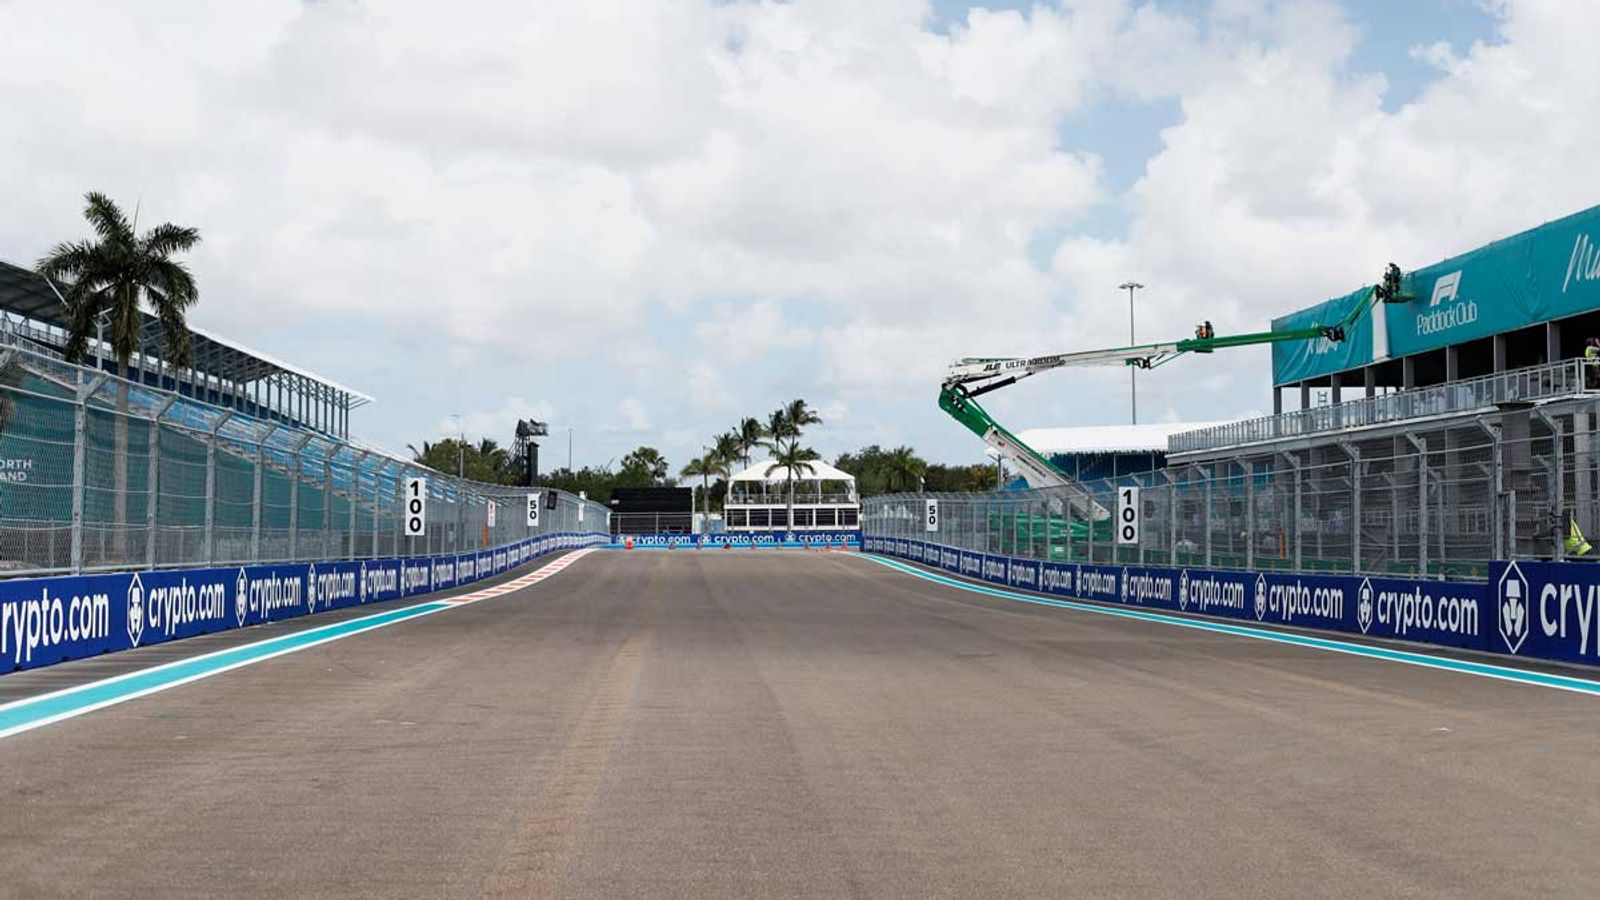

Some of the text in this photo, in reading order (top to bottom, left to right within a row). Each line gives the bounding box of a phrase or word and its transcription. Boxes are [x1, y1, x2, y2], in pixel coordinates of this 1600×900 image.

[1417, 299, 1477, 336] Paddock Club
[409, 480, 422, 533] 100
[529, 500, 537, 520] 50
[929, 505, 936, 525] 50
[1122, 489, 1135, 541] 100
[630, 534, 691, 545] rypto.com
[714, 534, 775, 545] crypto.com
[798, 533, 856, 543] crypto.com
[249, 571, 301, 618] crypto.com
[317, 566, 356, 607] crypto.com
[367, 564, 397, 599] crypto.com
[1044, 566, 1072, 592] crypto.com
[1082, 569, 1116, 596] crypto.com
[1129, 570, 1172, 603] crypto.com
[1190, 575, 1244, 611] crypto.com
[149, 577, 225, 636] crypto.com
[1269, 580, 1343, 620] crypto.com
[1377, 586, 1479, 636] crypto.com
